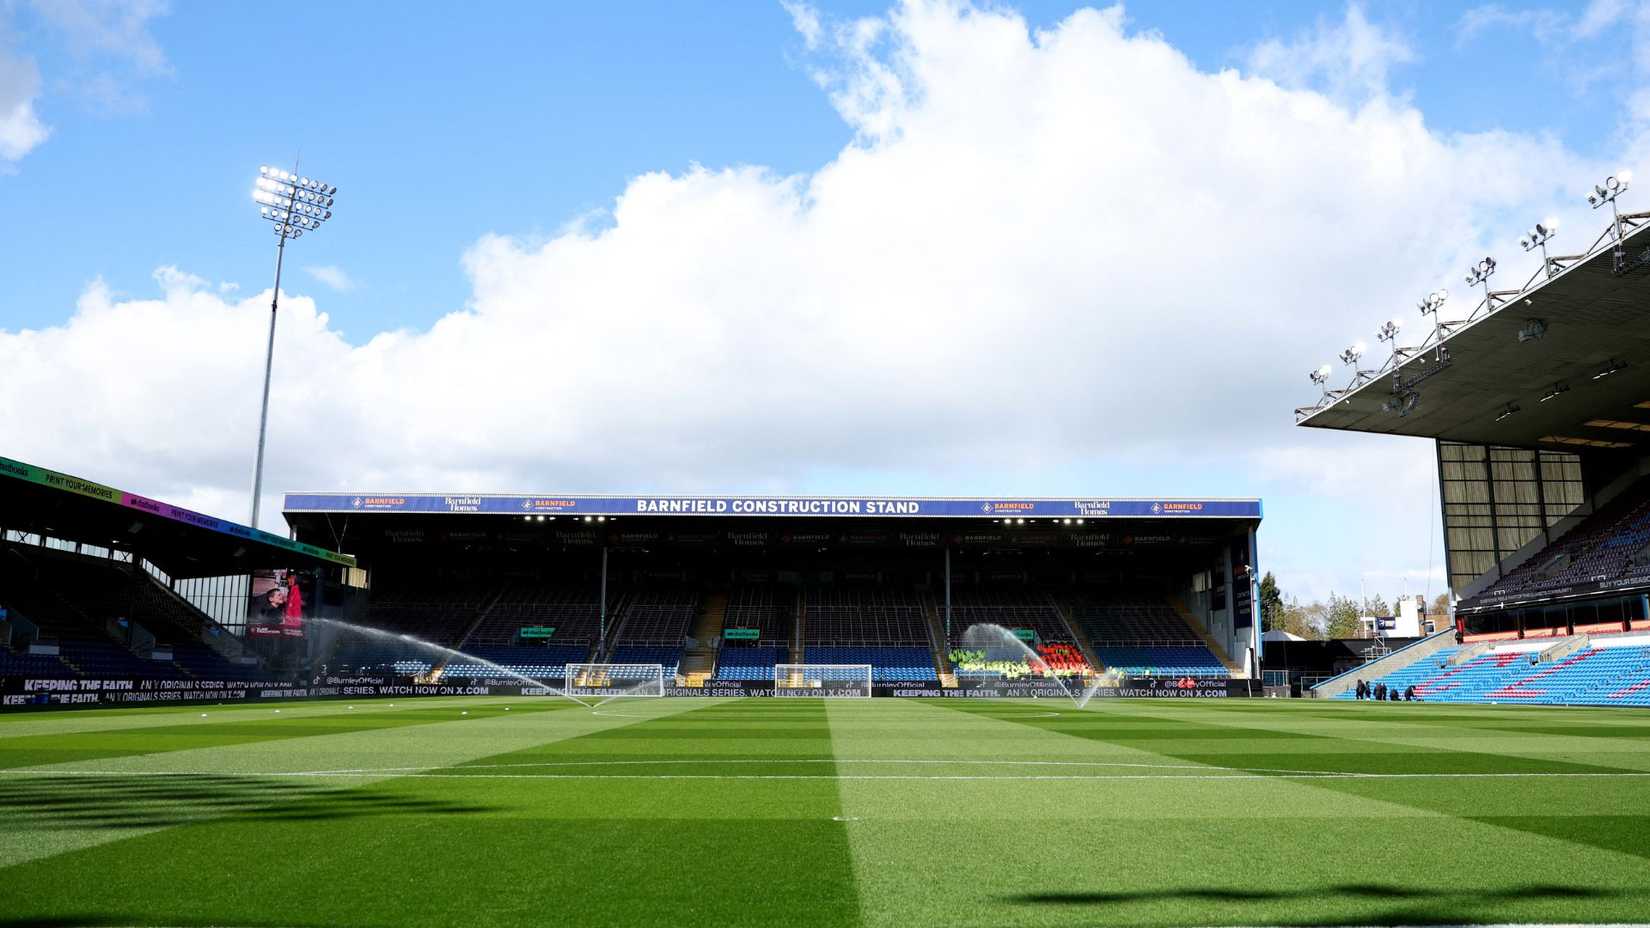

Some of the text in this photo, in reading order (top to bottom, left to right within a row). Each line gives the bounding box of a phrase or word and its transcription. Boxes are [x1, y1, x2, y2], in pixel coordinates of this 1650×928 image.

[637, 500, 920, 514] BARNFIELD CONSTRUCTION STAND
[1074, 500, 1110, 509] Barnfield
[25, 680, 78, 690] KEEPING
[80, 680, 101, 690] THE
[380, 686, 412, 694] WATCH
[415, 686, 437, 694] NOW
[440, 686, 454, 694] ON
[456, 686, 488, 695] X.COM
[711, 688, 747, 697] SERIES.
[811, 688, 826, 697] ON
[828, 688, 861, 697] X.COM
[893, 689, 941, 697] KEEPING
[942, 689, 964, 697] THE
[966, 689, 1000, 697] FAITH.
[1006, 688, 1020, 697] AN
[1030, 688, 1080, 697] ORIGINALS
[1120, 688, 1154, 697] WATCH
[1155, 689, 1178, 697] NOW
[1180, 689, 1193, 697] ON
[1195, 689, 1227, 697] X.COM
[122, 691, 158, 702] ORIGINALS
[184, 690, 203, 699] WATCH
